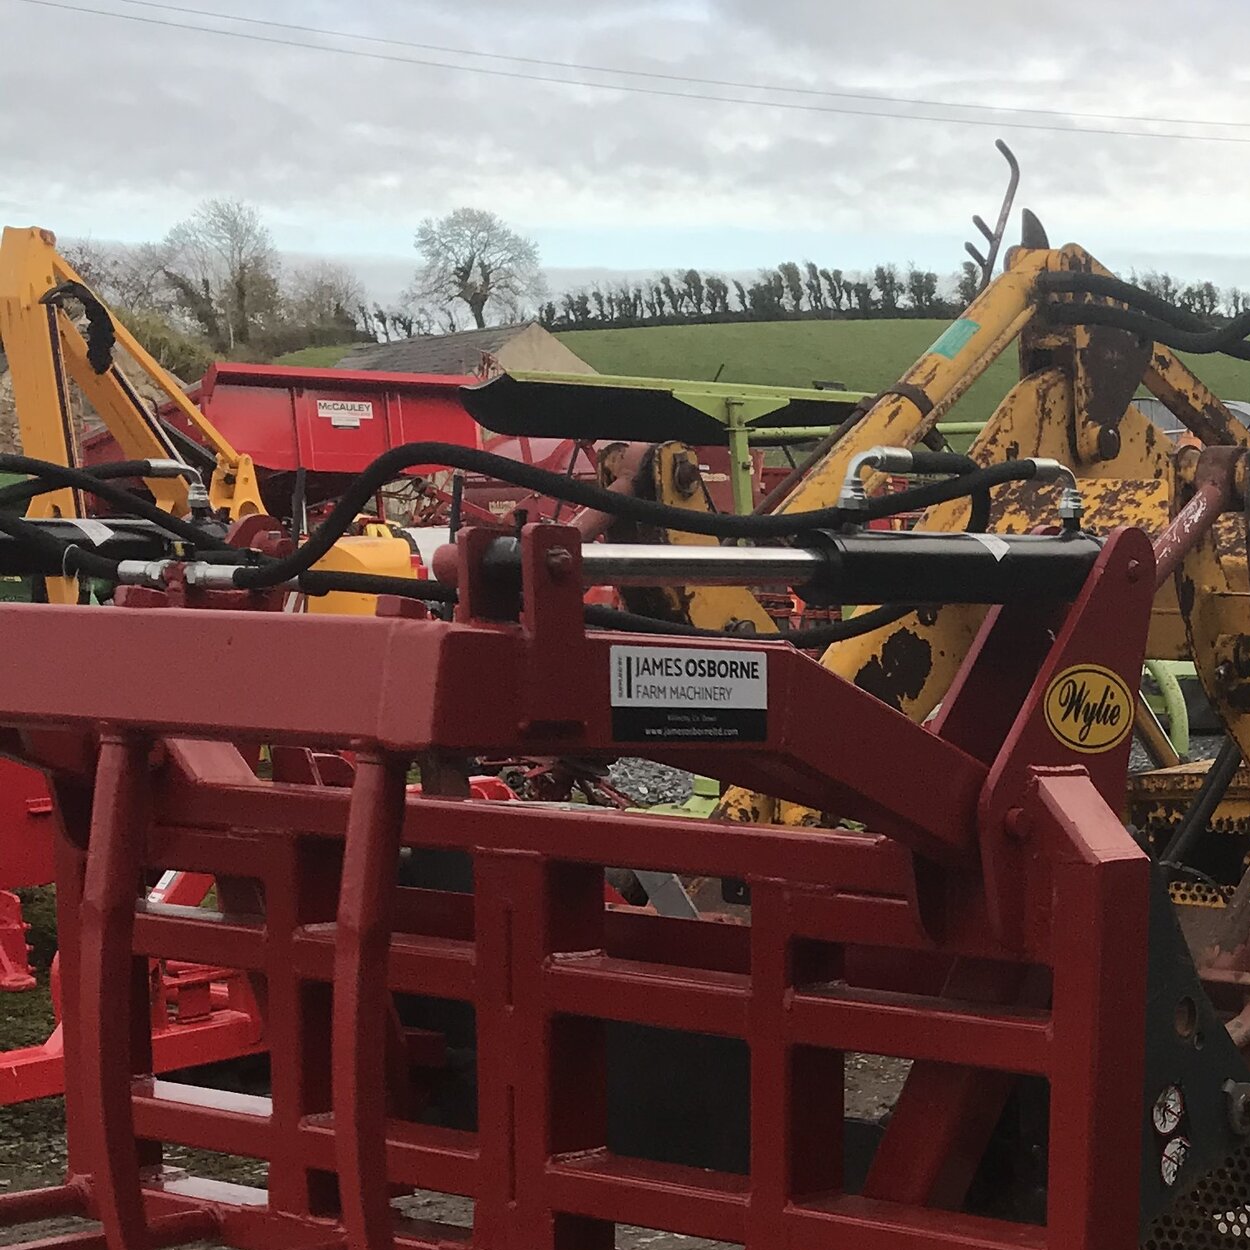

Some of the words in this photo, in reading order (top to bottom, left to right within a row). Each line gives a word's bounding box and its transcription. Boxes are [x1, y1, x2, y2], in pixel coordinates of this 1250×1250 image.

[318, 402, 371, 412] McCAULEY
[635, 656, 683, 678] JAMES
[685, 658, 760, 680] OSBORNE
[636, 684, 667, 700] FARM
[670, 685, 733, 701] MACHINERY
[1058, 679, 1121, 742] Wylie
